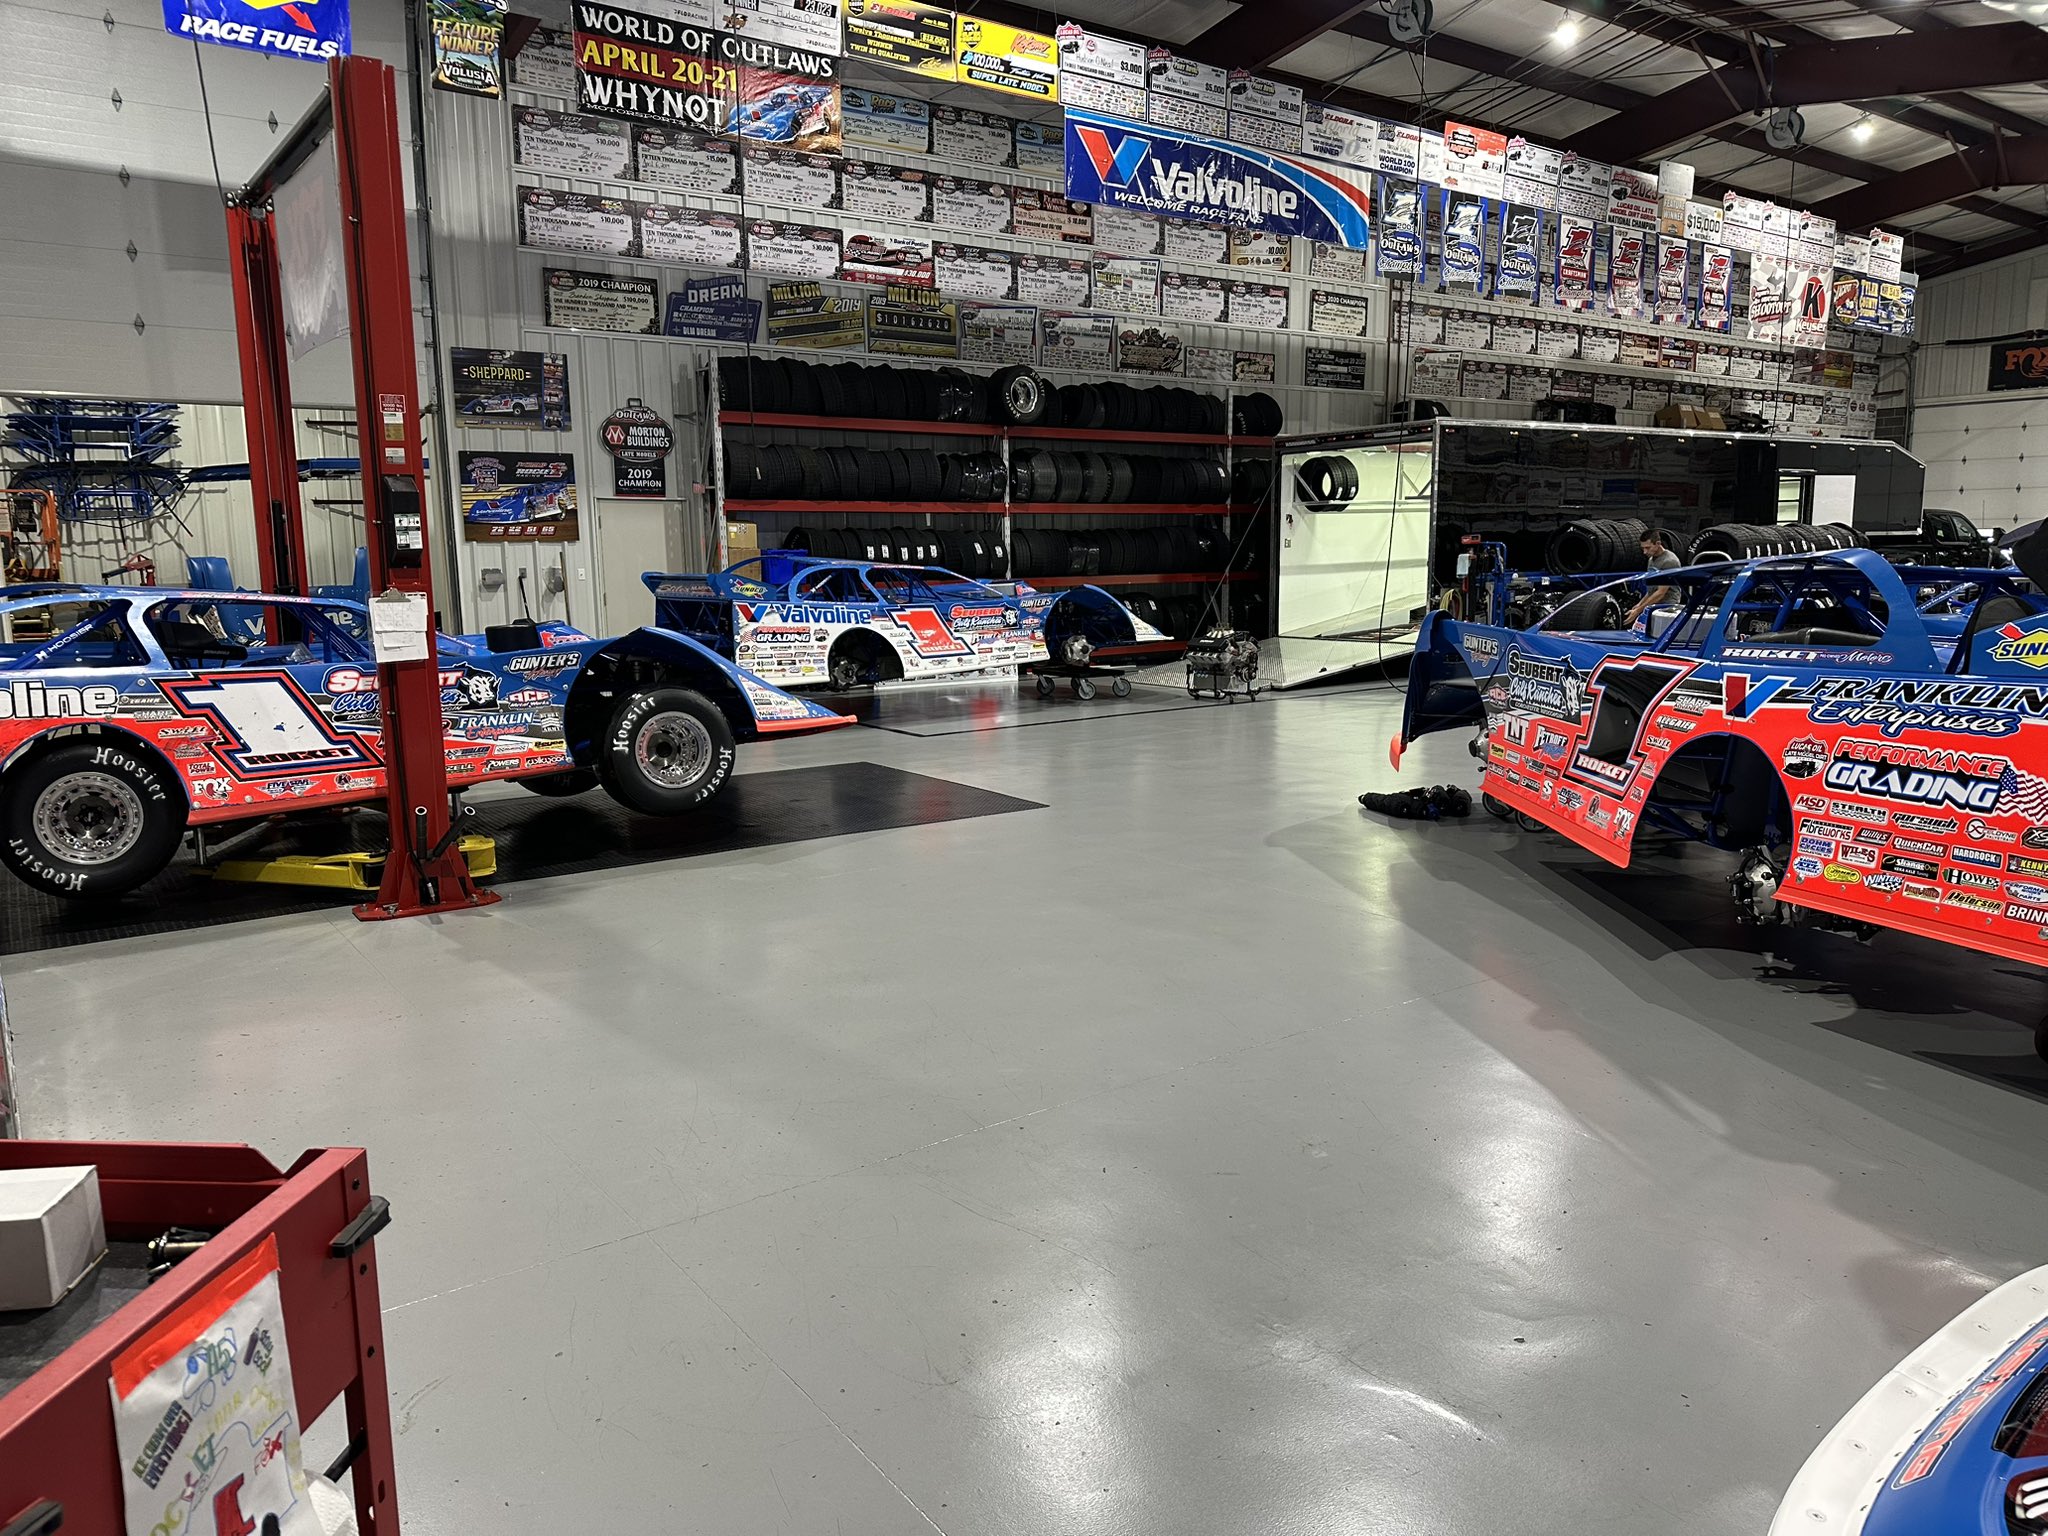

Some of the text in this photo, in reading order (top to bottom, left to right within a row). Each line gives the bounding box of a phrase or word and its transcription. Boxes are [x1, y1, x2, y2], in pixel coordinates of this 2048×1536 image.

[180, 14, 338, 58] RACE FUELS
[433, 19, 501, 41] FEATURE
[440, 34, 494, 55] WINNER
[580, 5, 674, 44] WORLD
[681, 28, 714, 53] OF
[721, 37, 833, 77] OUTLAWS
[867, 39, 893, 50] WINNER
[850, 43, 868, 52] TWIN
[878, 49, 910, 62] QUALIFIER
[582, 40, 737, 91] APRIL 20-21
[1098, 69, 1114, 78] DOLLARS
[443, 64, 496, 85] VOLUSIA
[972, 71, 1044, 92] SUPER LATE MODEL
[584, 74, 726, 126] WHYNOT
[1183, 90, 1199, 98] DOLLARS
[587, 103, 686, 126] MOTORSPORTS
[1325, 114, 1354, 125] ELDORA
[1313, 144, 1339, 156] WINNER
[1379, 155, 1415, 168] WORLD 100
[1380, 163, 1413, 175] CHAMPION
[809, 171, 828, 179] $10,000
[1151, 158, 1296, 219] Valvoline
[1114, 191, 1187, 212] WELCOME
[1189, 204, 1229, 222] RACE
[1610, 207, 1627, 216] MODEL
[1628, 210, 1640, 218] DIRT
[601, 216, 624, 225] $10,000
[1608, 215, 1656, 231] NATIONAL CHAMPION
[1664, 211, 1683, 220] WINNER
[1687, 214, 1720, 233] $15,000
[1445, 251, 1479, 266] OUTLAWS
[1502, 260, 1536, 274] OUTLAWS
[1563, 268, 1587, 278] CRAFTSMAN
[579, 279, 651, 293] 2019 CHAMPION
[688, 285, 744, 303] DREAM
[772, 284, 820, 300] MILLION
[871, 297, 886, 305] 2019
[888, 286, 940, 306] MILLION
[1803, 282, 1823, 319] K
[680, 305, 714, 313] CHAMPION
[834, 299, 861, 313] 2019
[1750, 300, 1792, 318] SHOOTOUT
[1795, 318, 1827, 334] Keyser
[469, 366, 525, 381] SHEPPARD
[615, 410, 656, 423] OUTLAWS
[629, 426, 665, 438] MORTON
[627, 436, 669, 448] BUILDINGS
[627, 469, 652, 479] 2019
[619, 479, 662, 488] CHAMPION
[1021, 599, 1051, 608] GUNTER'S
[775, 604, 872, 624] Valvoline
[952, 607, 1004, 617] SEUBERT
[49, 623, 93, 652] HOOSIER
[756, 633, 811, 642] GRADING
[893, 606, 970, 655] 1
[1002, 630, 1031, 638] FRANKLIN
[1464, 634, 1498, 654] GUNTER'S
[511, 653, 579, 670] GUNTER'S
[1722, 648, 1819, 660] ROCKET
[1508, 651, 1564, 684] SEUBERT
[509, 691, 549, 701] ACE
[1511, 677, 1528, 700] Calf
[1677, 695, 1711, 707] SHARP
[1803, 676, 2048, 720] FRANKLIN
[172, 676, 376, 770] 1
[459, 712, 533, 728] FRANKLIN
[1814, 698, 2016, 733] Enterprises
[159, 726, 208, 737] Swift
[613, 696, 655, 754] Hoosier
[1503, 712, 1528, 747] TNT
[1534, 725, 1567, 748] PETROFF
[1648, 736, 1671, 747] Swift
[1791, 741, 1822, 752] LUCAS OIL
[241, 748, 352, 765] ROCKET
[489, 759, 520, 767] POWERS
[1835, 740, 2005, 779] PERFORMANCE
[90, 746, 166, 800] Hoosier
[189, 763, 211, 771] TOTAL
[696, 746, 732, 801] Hoosier
[1577, 754, 1630, 782] ROCKET
[193, 777, 233, 795] FOX
[1826, 761, 2000, 808] GRADING
[1797, 796, 1825, 808] MSD
[1832, 802, 1886, 816] STEALTH
[1800, 819, 1851, 840] Fibreworks
[1861, 829, 1888, 840] Willy's
[1800, 843, 1833, 854] CYCLES
[1802, 837, 1832, 847] DOHM
[1894, 837, 1945, 856] QUICKCAR
[1842, 845, 1876, 862] WILES
[1953, 848, 1996, 862] HARDROCK
[9, 839, 88, 891] Hoosier
[1863, 875, 1903, 886] WINTERS
[1951, 869, 1995, 885] HOWE
[1948, 891, 2001, 910] Peterson
[132, 1455, 149, 1479] ICE
